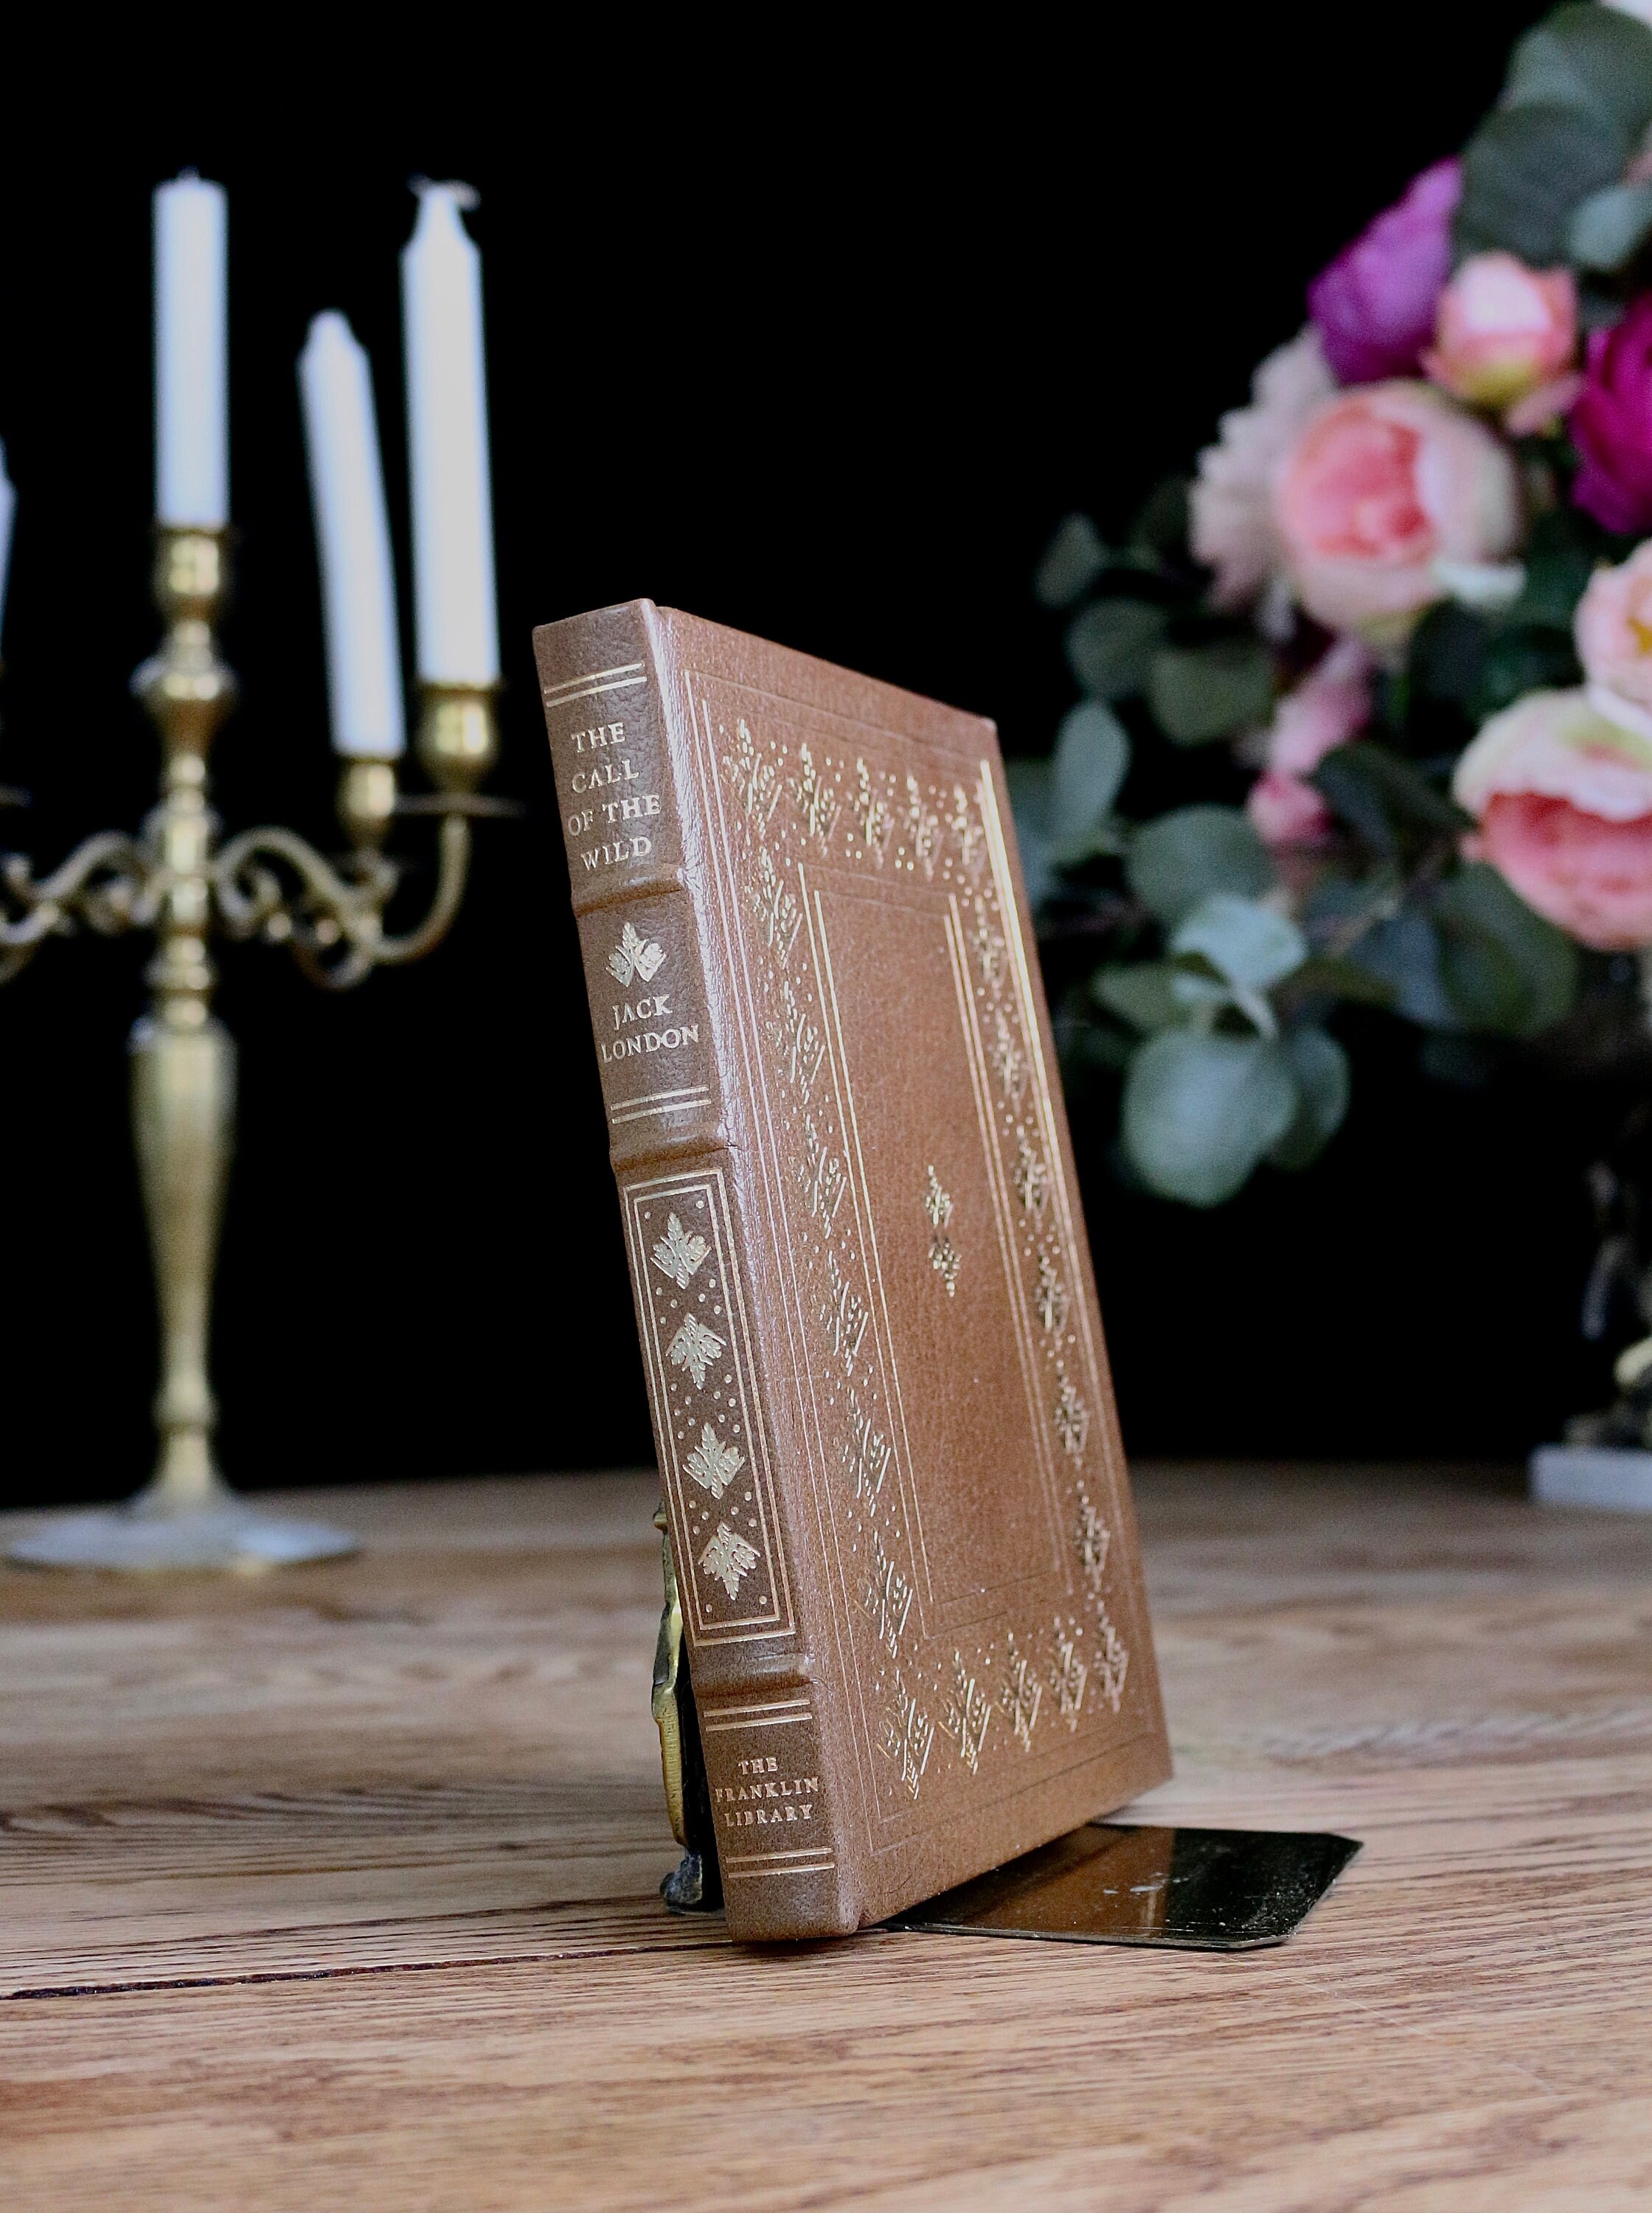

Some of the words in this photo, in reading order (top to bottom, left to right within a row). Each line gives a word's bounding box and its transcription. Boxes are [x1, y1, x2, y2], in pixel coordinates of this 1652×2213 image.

[572, 721, 625, 753] THE
[572, 759, 639, 794] CALL
[567, 810, 594, 837] OF
[602, 794, 662, 824] THE
[580, 836, 653, 871] WILD
[612, 994, 673, 1031] JACK
[601, 1023, 699, 1063] LONDON
[738, 1756, 778, 1775] THE
[715, 1776, 819, 1803] FRANKLIN
[724, 1804, 813, 1827] LIBRARY
